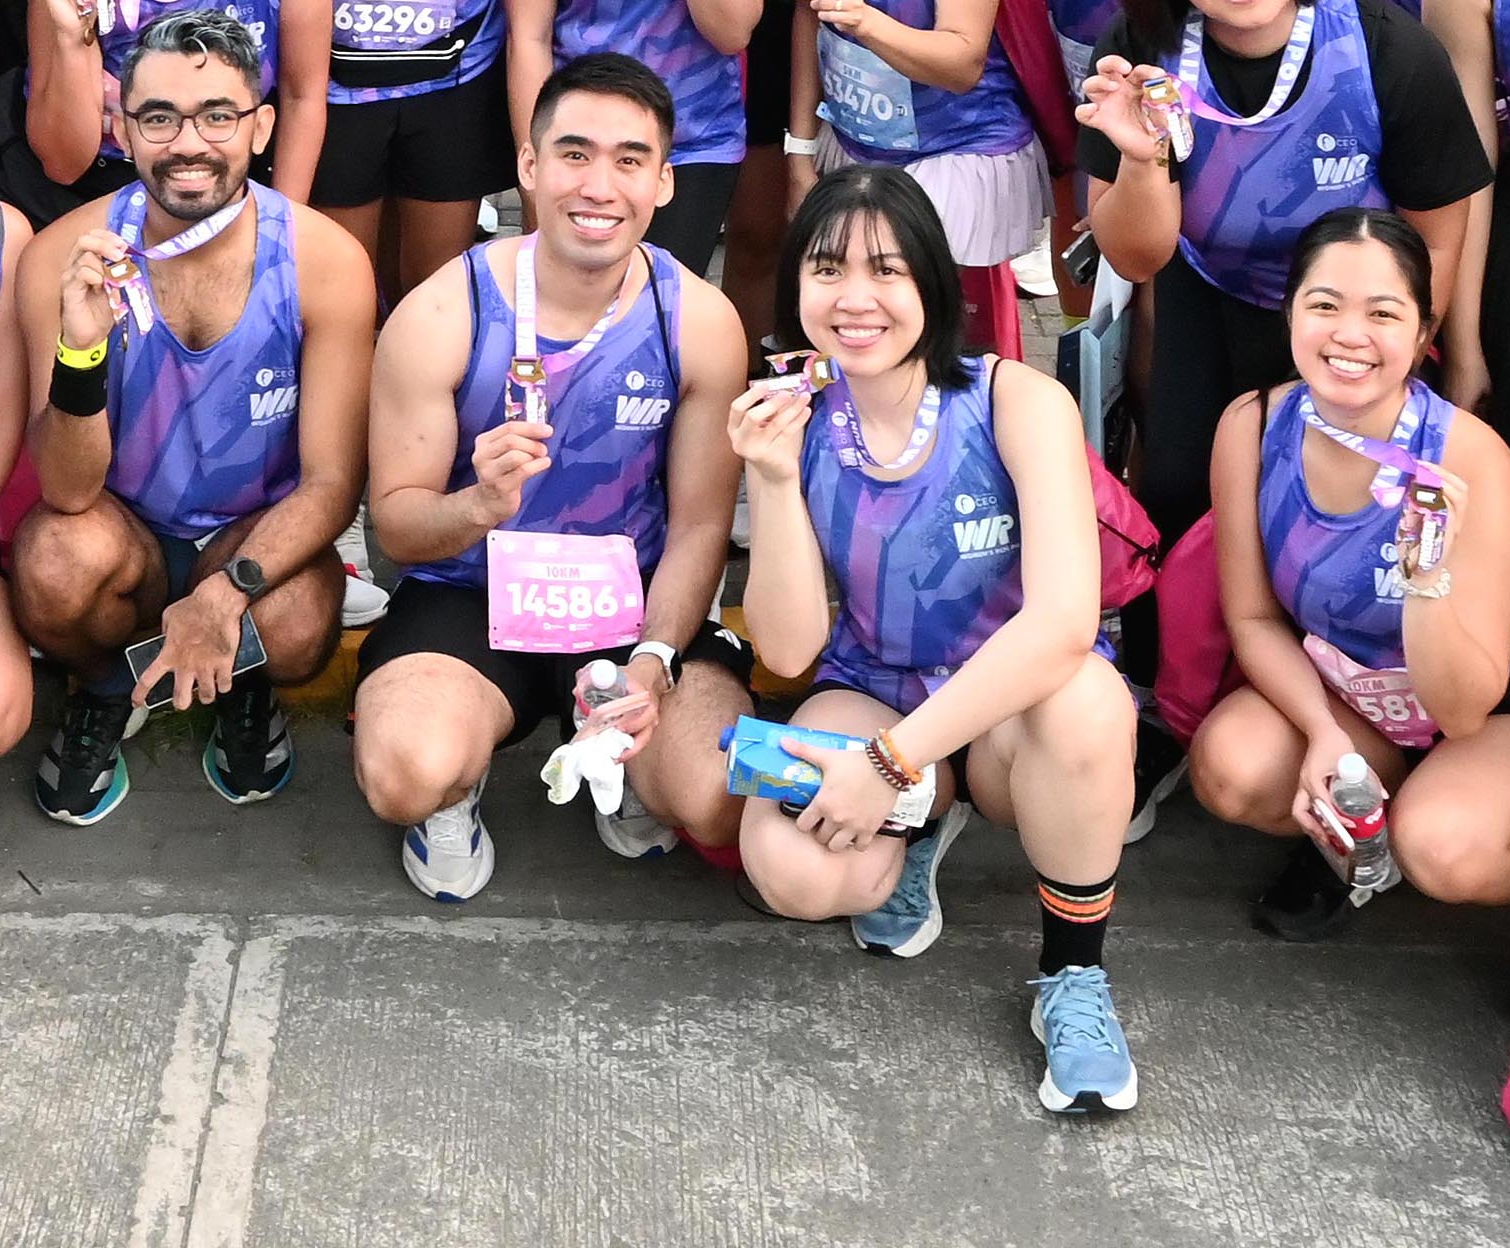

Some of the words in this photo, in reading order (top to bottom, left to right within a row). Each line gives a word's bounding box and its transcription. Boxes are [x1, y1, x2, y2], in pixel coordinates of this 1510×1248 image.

[334, 2, 436, 35] 63296
[1312, 153, 1370, 185] WR
[645, 378, 665, 388] CEO
[615, 395, 671, 425] WR
[976, 496, 998, 507] CEO
[953, 514, 1015, 552] WR
[546, 565, 580, 579] 10KM
[506, 582, 619, 619] 14586
